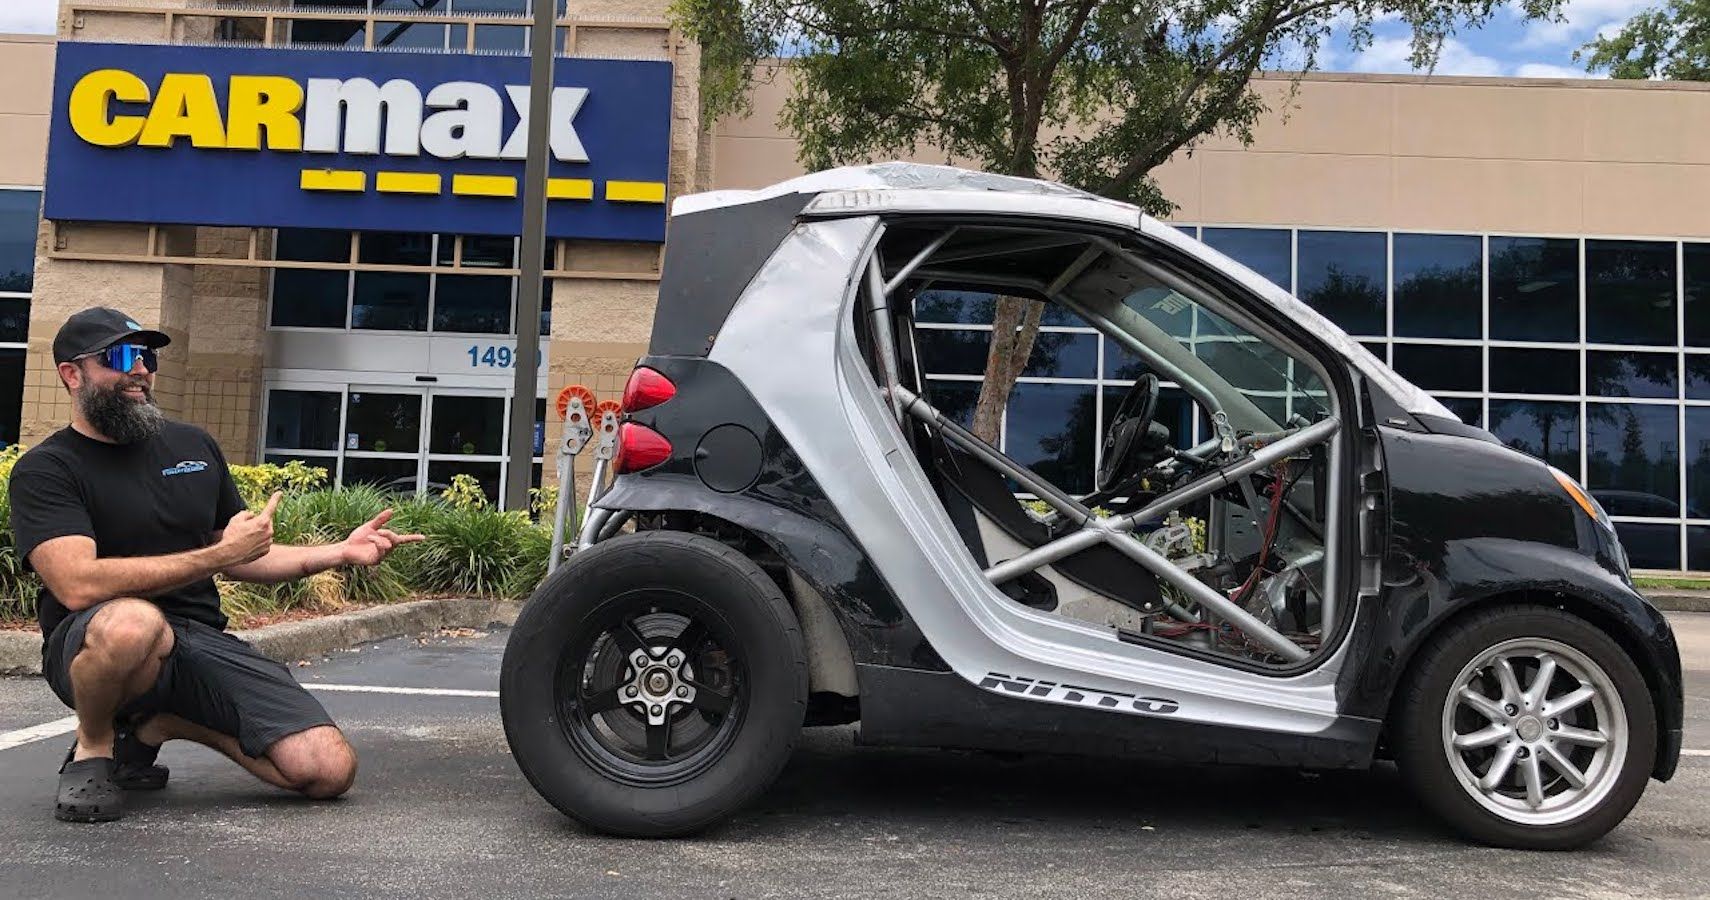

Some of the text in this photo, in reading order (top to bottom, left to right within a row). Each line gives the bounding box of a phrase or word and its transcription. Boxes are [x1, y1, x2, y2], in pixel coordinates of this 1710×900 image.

[69, 69, 590, 163] CARmax
[468, 345, 542, 368] 149
[979, 672, 1180, 714] NITTO
